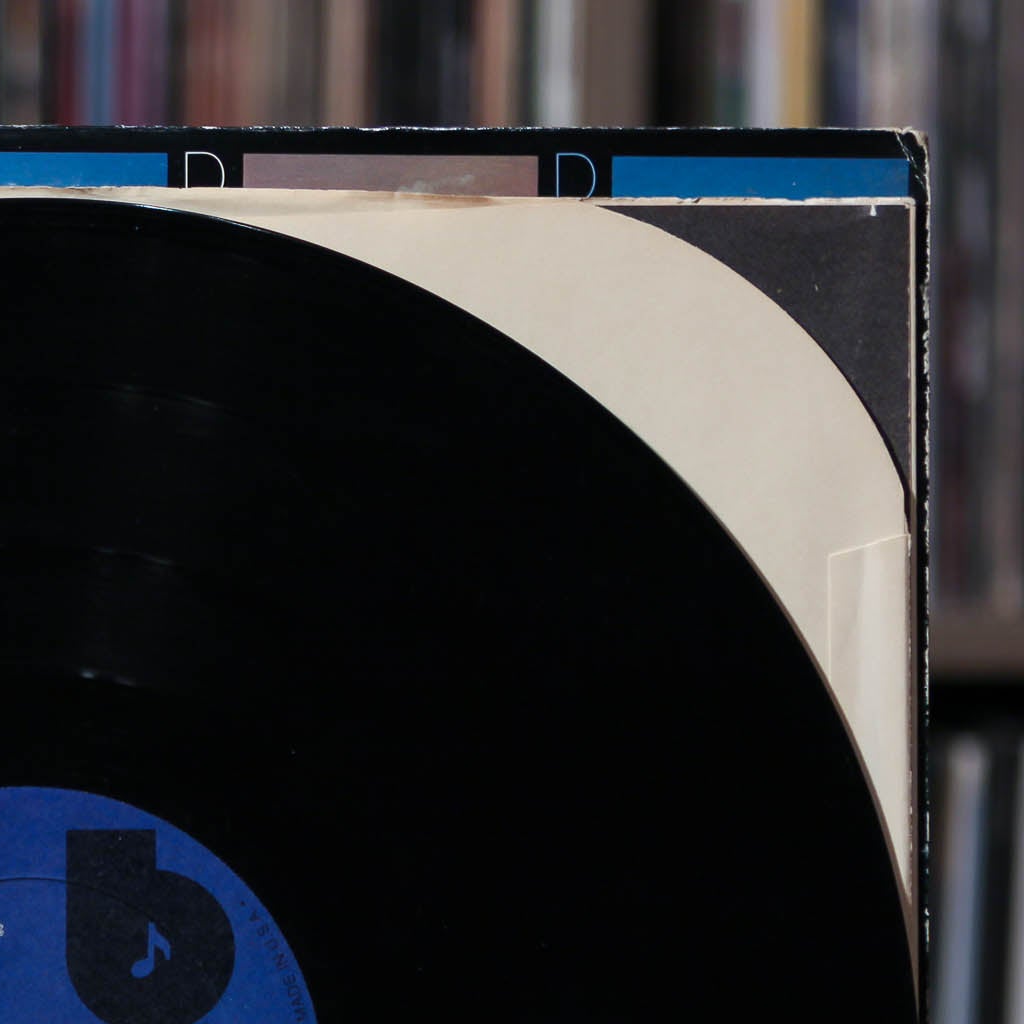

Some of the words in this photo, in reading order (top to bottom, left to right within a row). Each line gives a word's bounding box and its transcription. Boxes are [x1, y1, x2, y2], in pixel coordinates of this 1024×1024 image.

[555, 152, 596, 198] D
[272, 951, 292, 970] IN
[282, 972, 310, 1022] MADE
